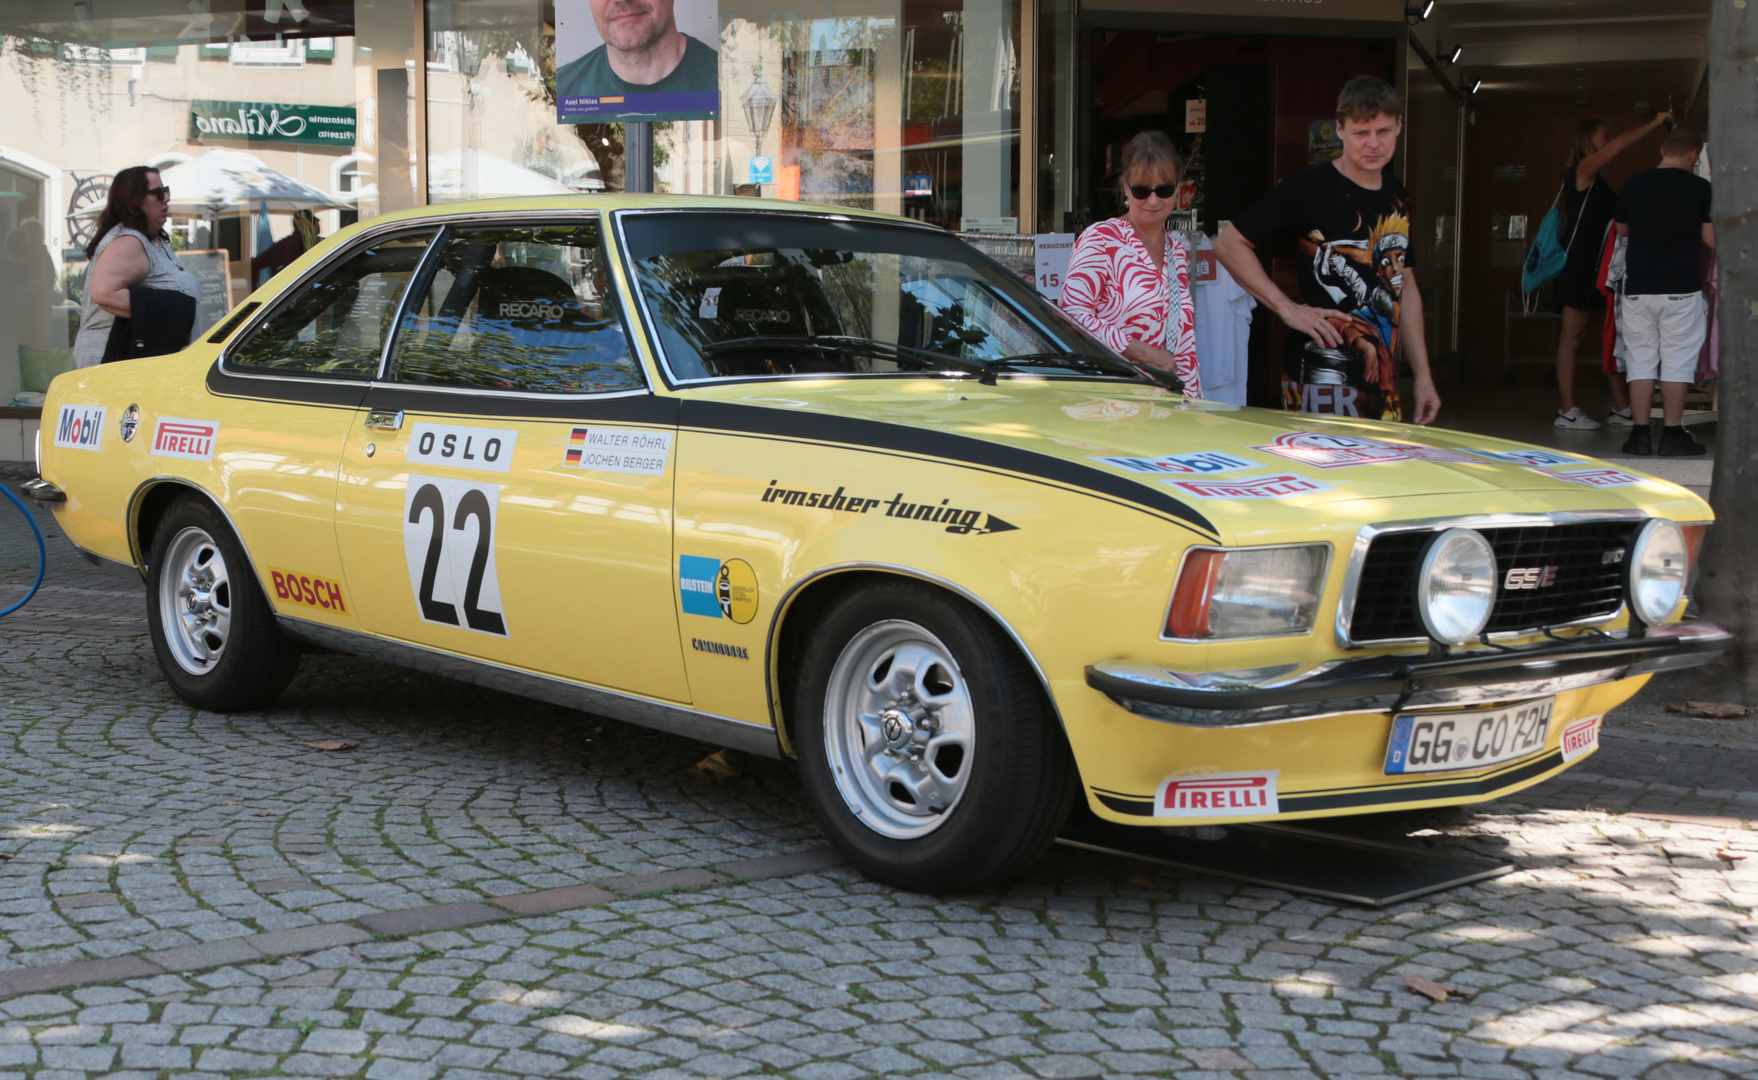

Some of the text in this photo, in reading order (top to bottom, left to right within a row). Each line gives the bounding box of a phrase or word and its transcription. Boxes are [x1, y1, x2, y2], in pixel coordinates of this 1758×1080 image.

[564, 98, 578, 106] Axel
[579, 98, 598, 106] Niklas
[1038, 242, 1074, 250] REDUZIERT
[499, 302, 565, 319] RECARO
[735, 308, 791, 324] RECARO
[58, 408, 102, 446] Mobil
[155, 422, 214, 456] PIRELLI
[418, 431, 502, 463] OSLO
[589, 433, 668, 450] WALTER RÖHRL
[582, 453, 663, 470] JOCHEN BERGER
[1103, 453, 1250, 473] Mobil
[1173, 475, 1320, 497] PIRELLI
[761, 479, 991, 535] irmscher tuning
[408, 483, 507, 636] 22
[271, 570, 346, 612] BOSCH
[680, 577, 714, 594] BILSTEIN
[1408, 702, 1552, 765] GG CO 72H
[1563, 717, 1599, 755] PIRELLI
[1392, 750, 1402, 763] D
[1164, 776, 1267, 809] PIRELLI
